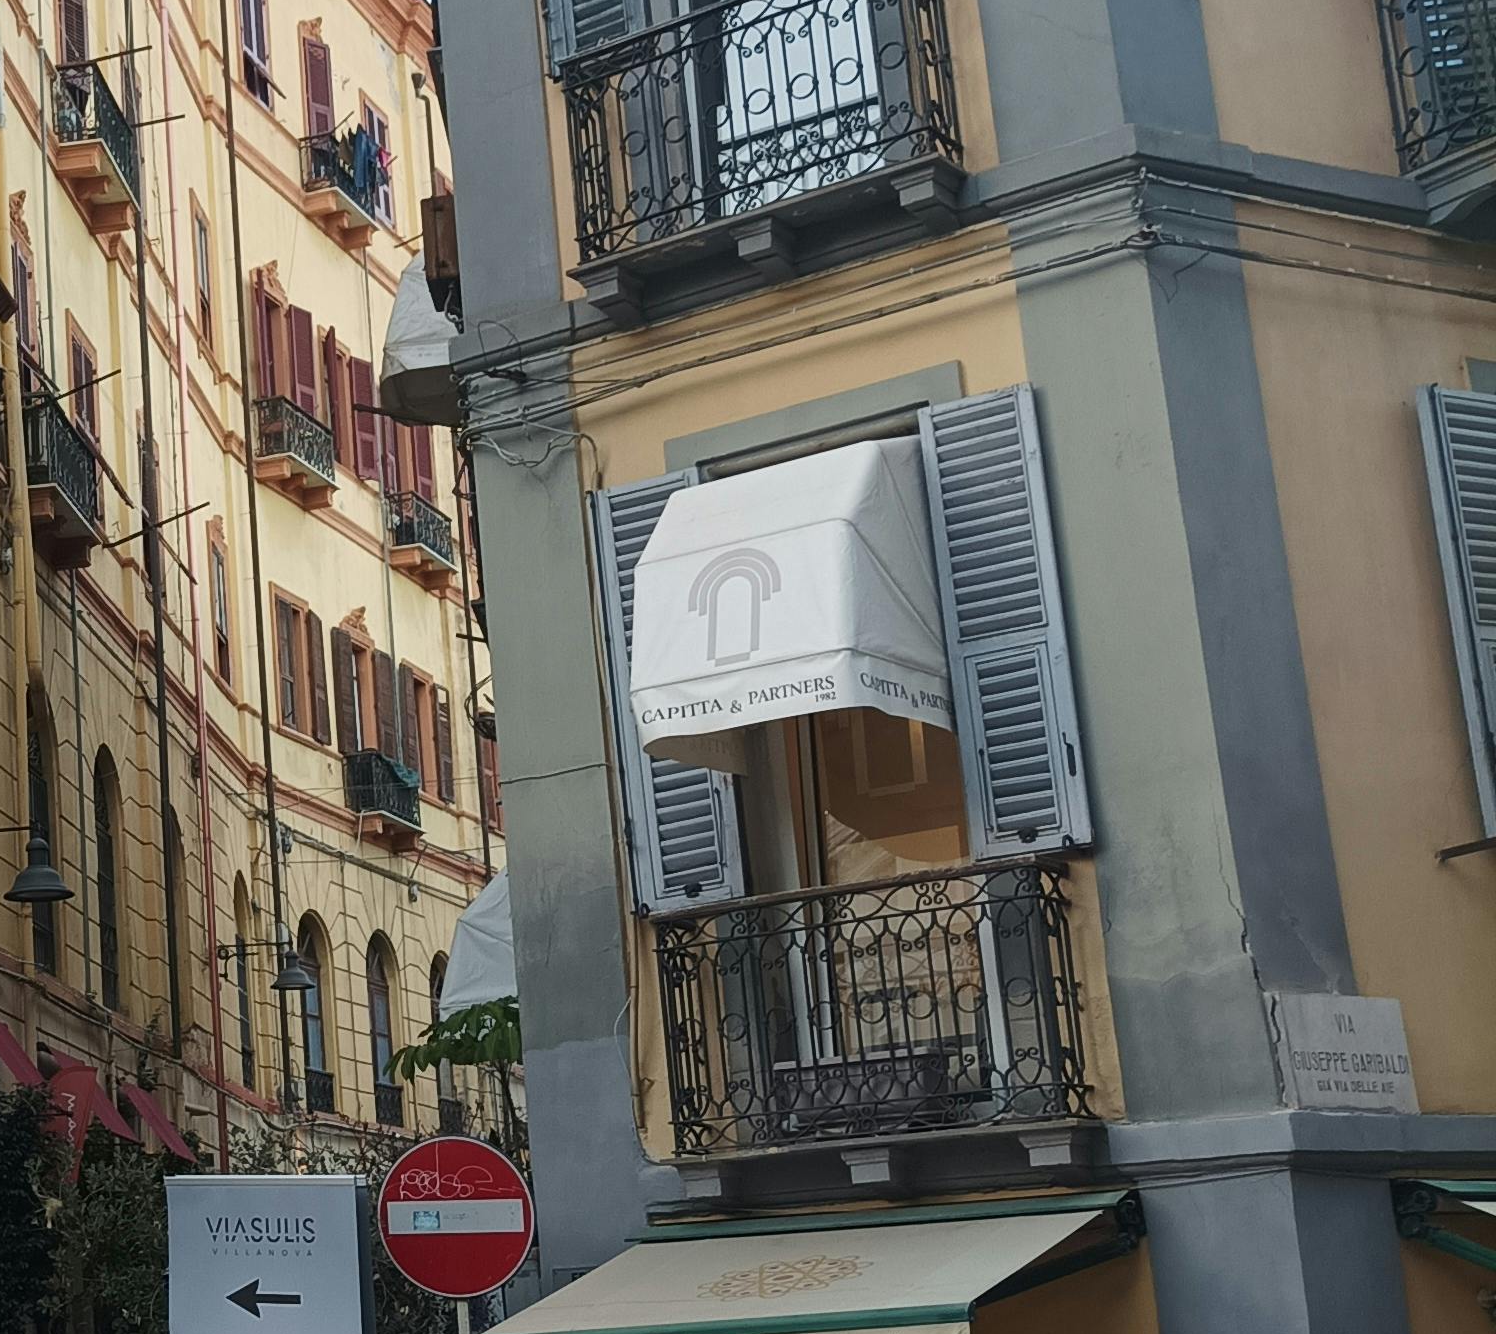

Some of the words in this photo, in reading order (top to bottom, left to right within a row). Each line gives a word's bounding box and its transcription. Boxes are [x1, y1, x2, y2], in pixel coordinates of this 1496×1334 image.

[815, 692, 837, 703] 1982
[860, 672, 909, 701] CAPITTA
[642, 700, 723, 725] CAPITTA
[730, 701, 742, 714] &
[748, 675, 835, 705] PARTNERS
[1334, 1013, 1356, 1035] VIA
[1293, 1050, 1350, 1073] GIUSEPPE
[1351, 1053, 1410, 1075] GARIBALDI
[1333, 1080, 1348, 1092] VIA
[1350, 1080, 1379, 1093] DELLE
[212, 1247, 313, 1257] VILLANOVA
